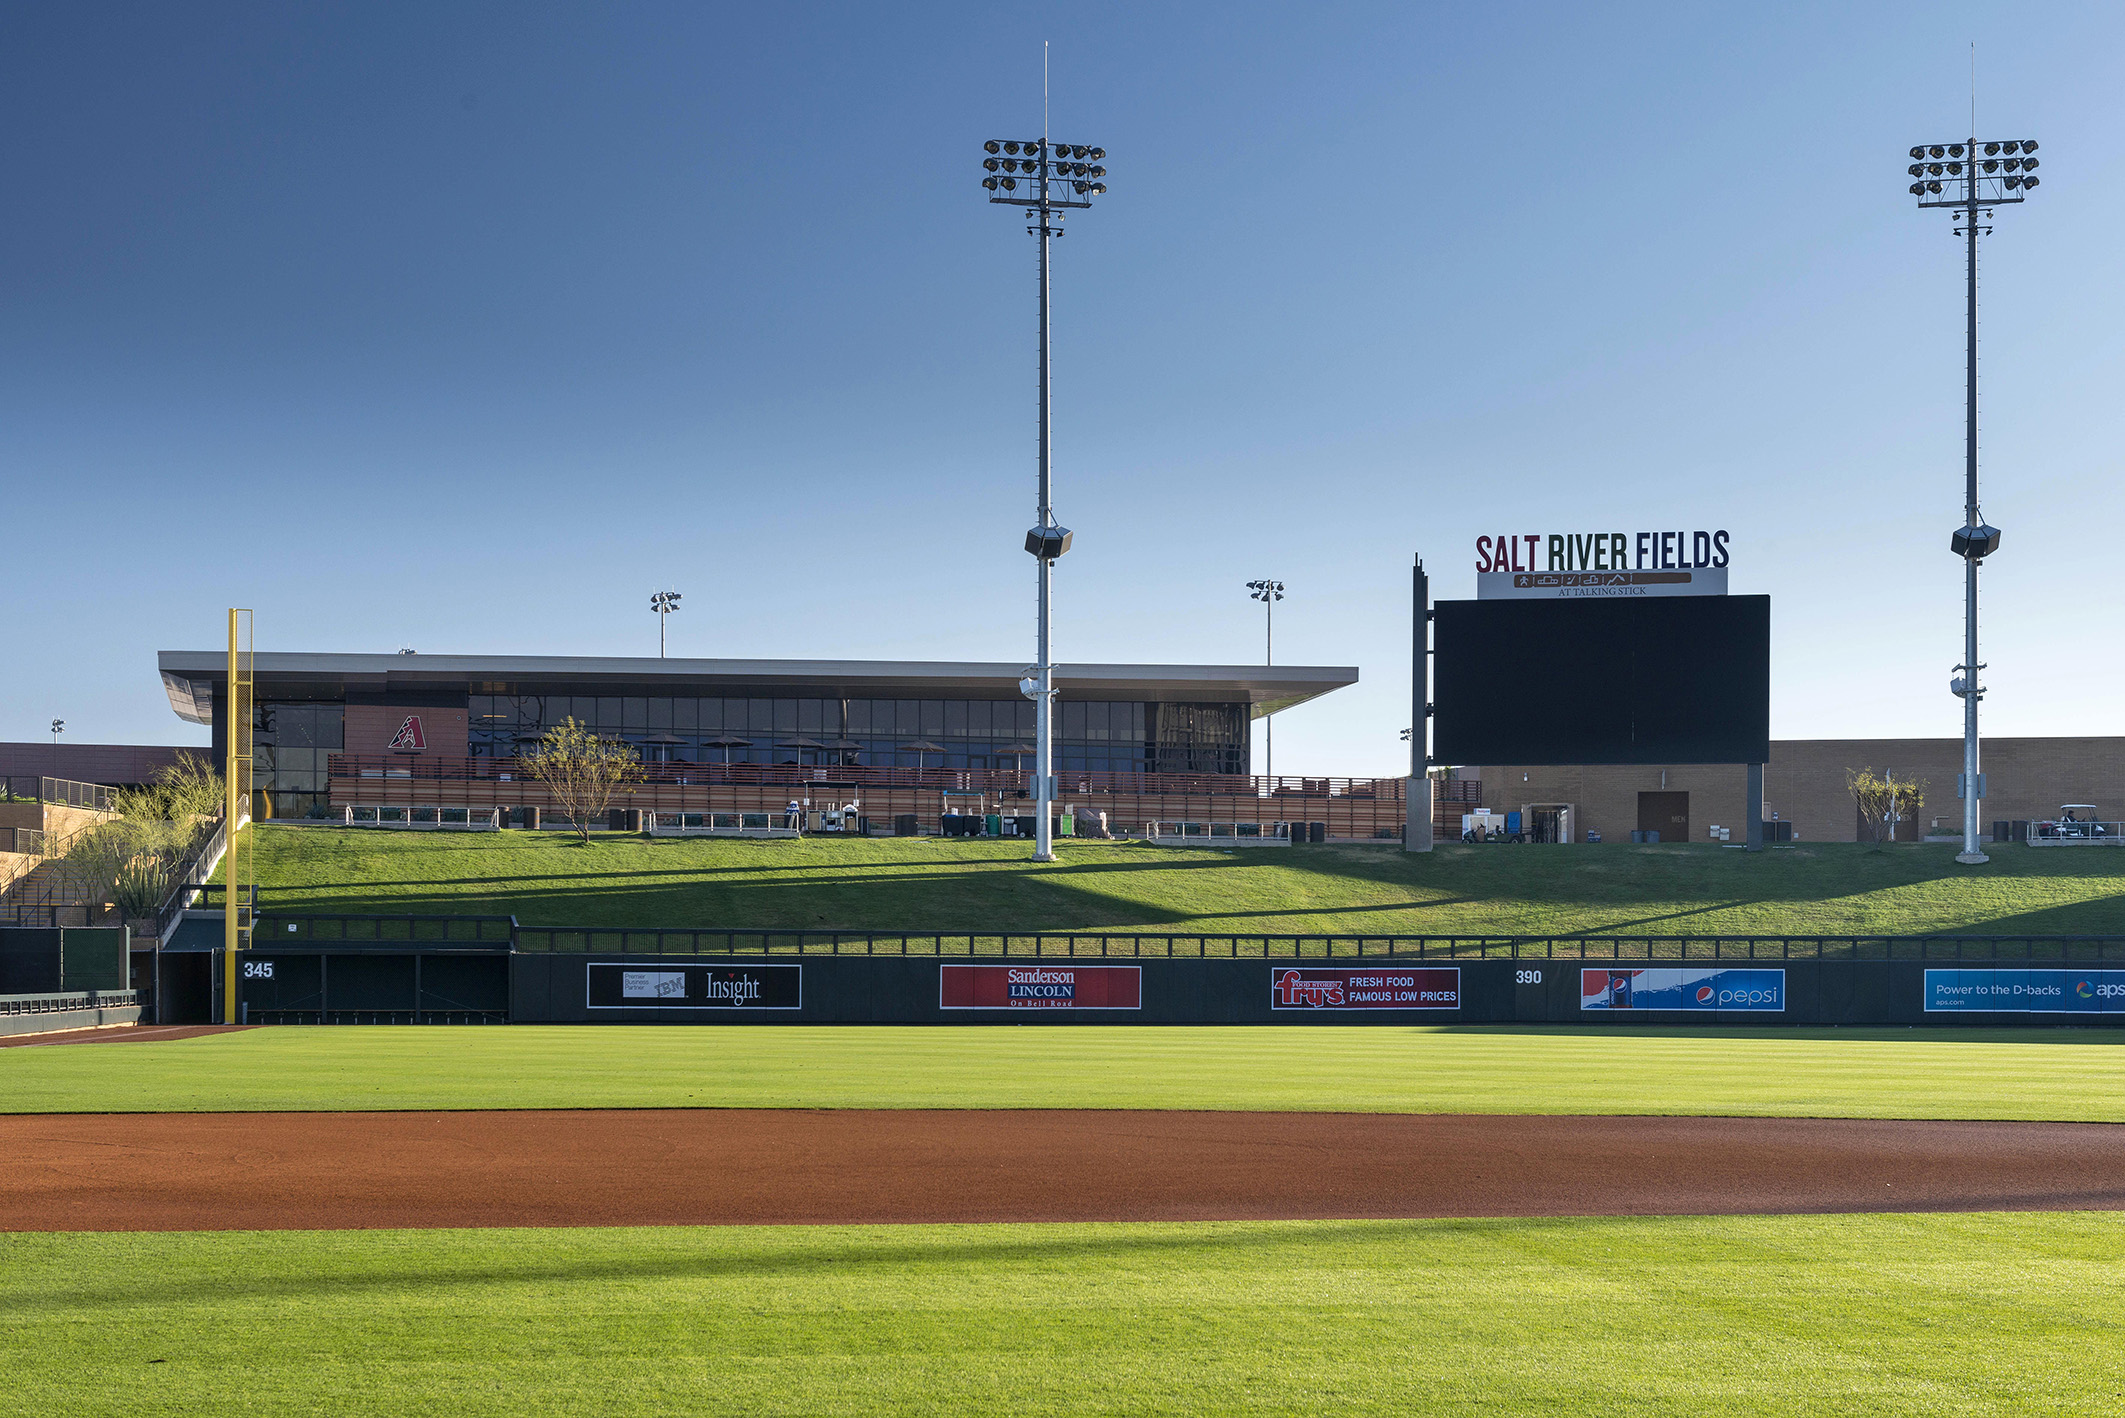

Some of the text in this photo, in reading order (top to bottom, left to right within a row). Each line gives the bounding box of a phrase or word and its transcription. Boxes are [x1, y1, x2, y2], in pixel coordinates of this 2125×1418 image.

[1476, 530, 1729, 573] SALT RIVER FIELDS
[1558, 586, 1646, 596] AT TALKING STICK
[244, 962, 273, 978] 345
[1008, 969, 1075, 983] Sanderson
[1515, 970, 1542, 984] 390
[653, 976, 685, 997] IBM
[706, 972, 760, 1006] Insight
[1349, 977, 1414, 987] FRESH FOOD
[1010, 985, 1073, 997] LINCOLN
[1349, 991, 1457, 1002] FAMOUS LOW PRICES
[1718, 987, 1777, 1006] pepsi
[1936, 985, 2061, 996] Power to the D-backs
[2096, 984, 2125, 998] aps
